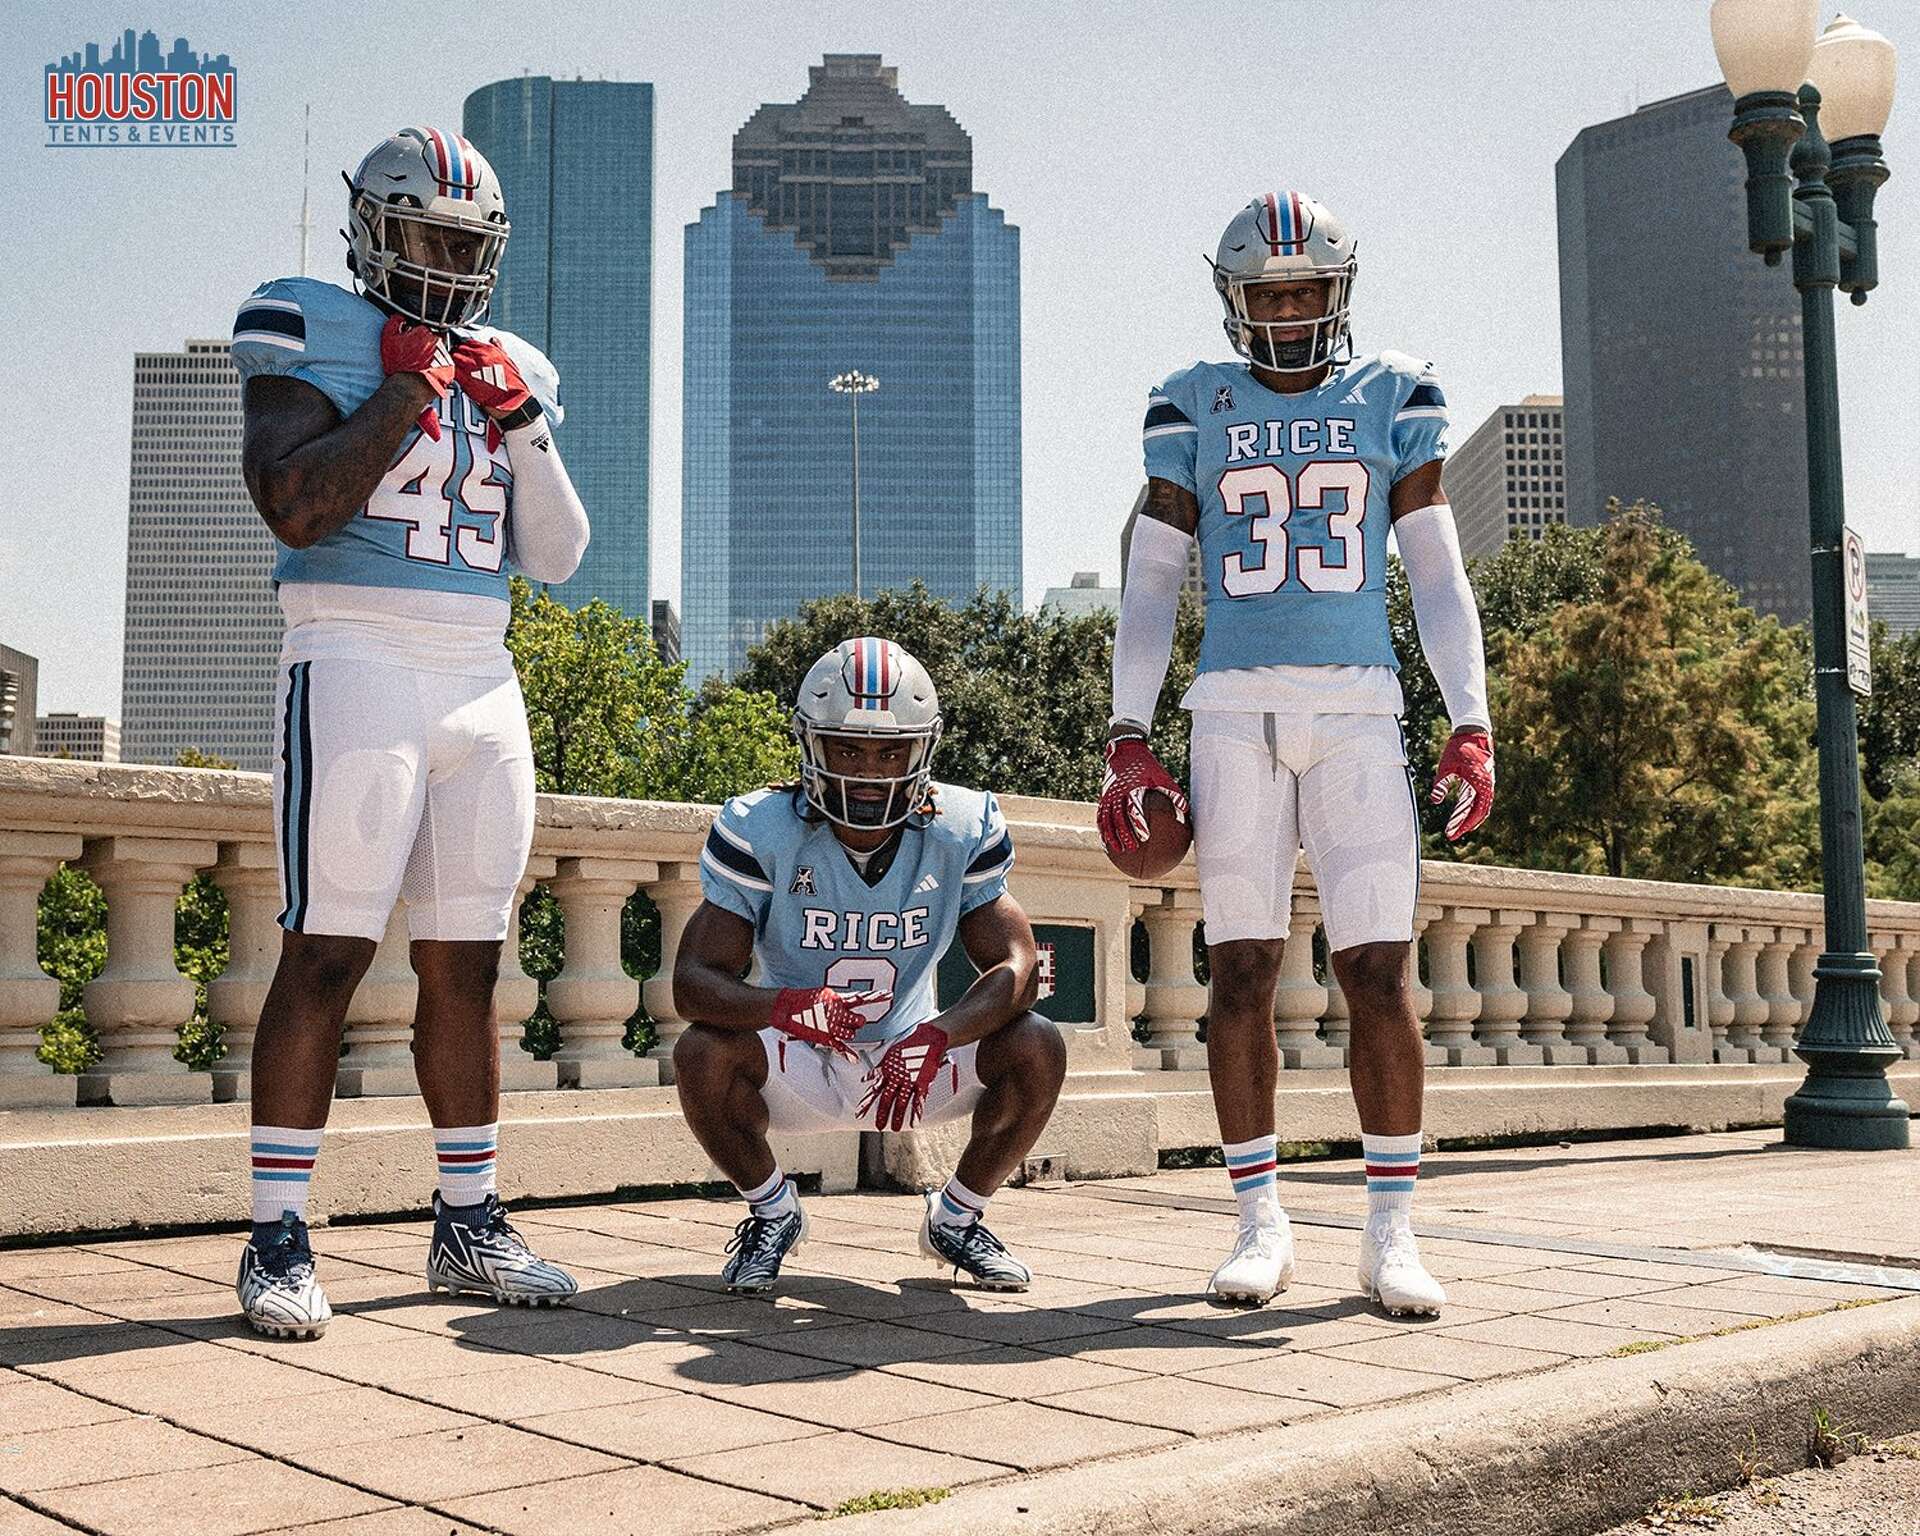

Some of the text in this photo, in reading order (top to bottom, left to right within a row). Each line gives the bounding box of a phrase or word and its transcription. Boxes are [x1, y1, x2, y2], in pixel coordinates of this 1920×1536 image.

[1226, 417, 1356, 462] RICE
[364, 428, 513, 573] 45
[1218, 460, 1370, 597] 33
[802, 907, 929, 952] RICE
